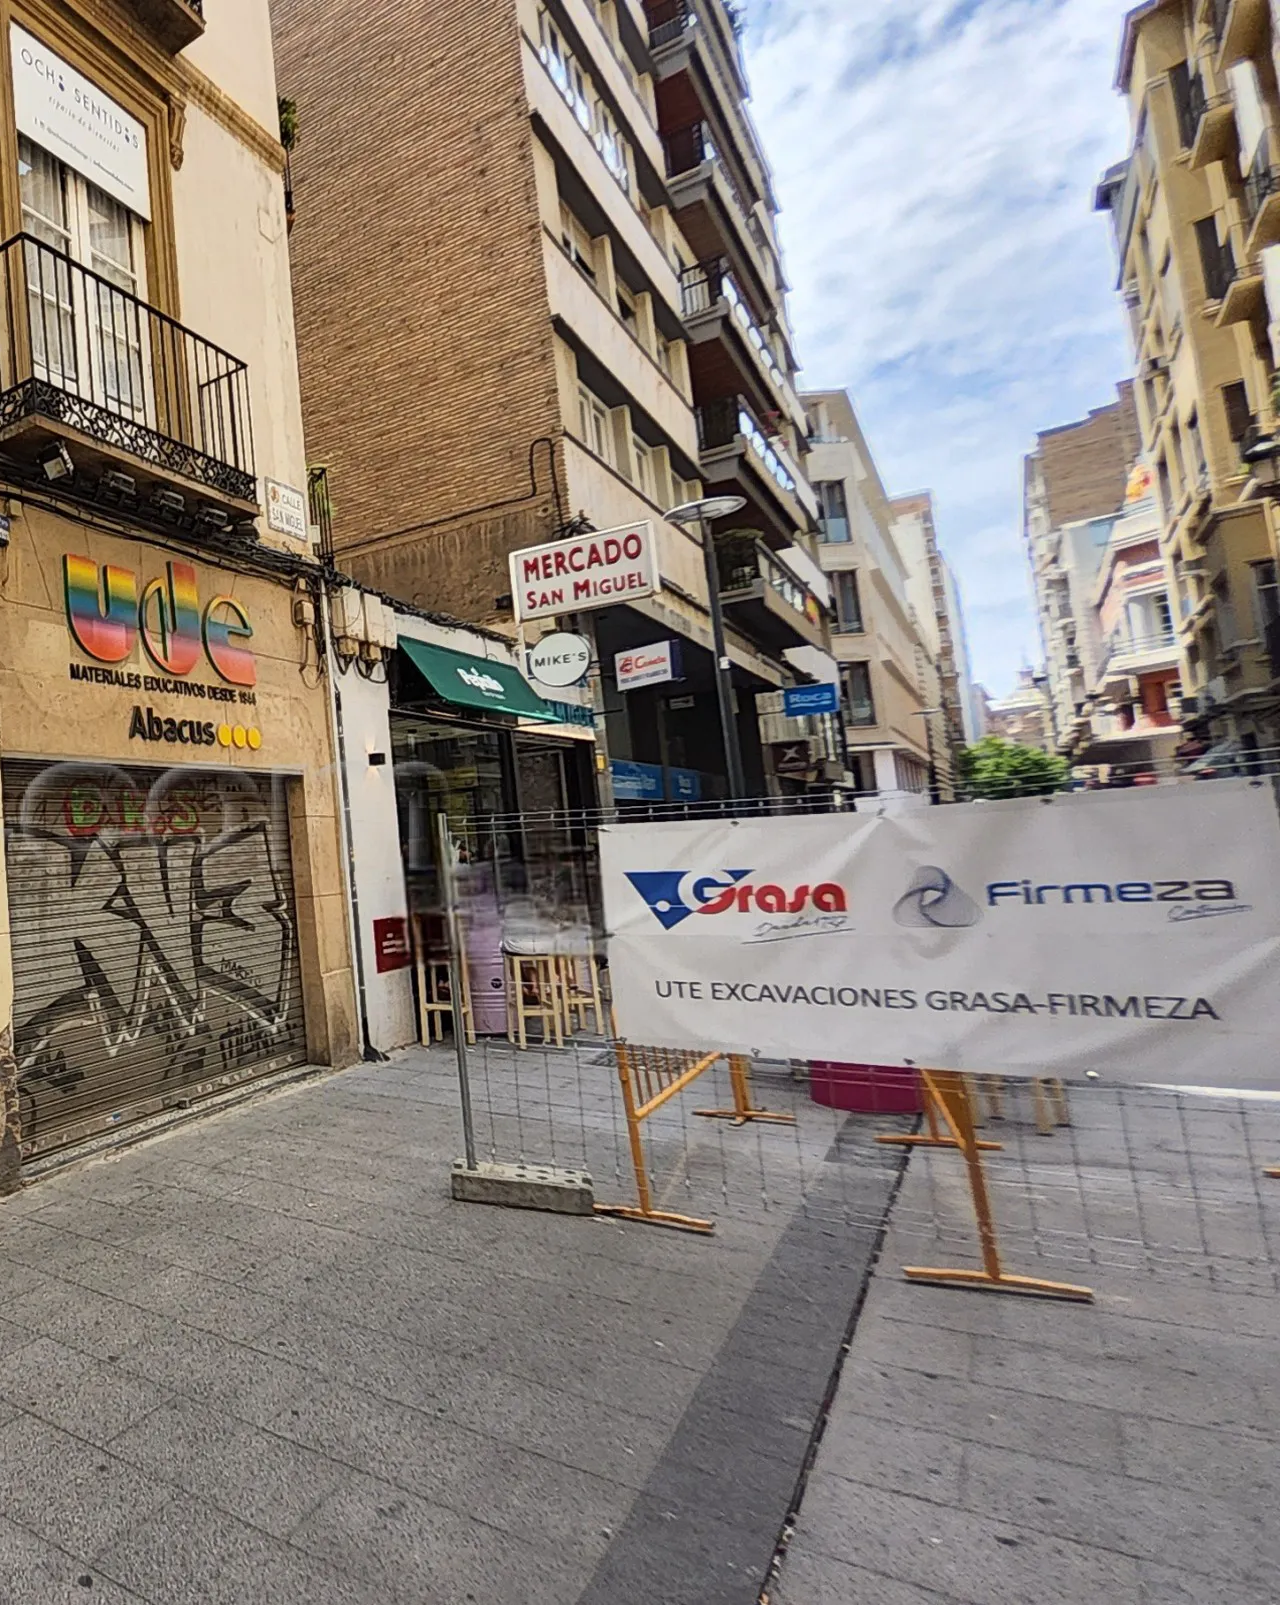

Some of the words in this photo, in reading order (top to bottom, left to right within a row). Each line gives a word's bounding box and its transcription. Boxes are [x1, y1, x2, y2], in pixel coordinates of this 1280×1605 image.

[523, 533, 642, 583] MERCADO
[527, 589, 564, 610] SAN
[573, 572, 648, 600] MIGUEL
[535, 651, 587, 668] MIKE'S
[70, 663, 142, 690] MATERIALES
[144, 675, 206, 699] EDUCATIVOS
[207, 686, 237, 703] DESDE
[789, 692, 832, 704] Roca
[129, 705, 216, 745] Abacus
[678, 870, 848, 914] Grasa
[986, 879, 1238, 906] Firmeza
[655, 980, 703, 1000] UTE
[711, 982, 918, 1010] EXCAVACIONES
[925, 989, 1221, 1021] GRASA-FIRMEZA
